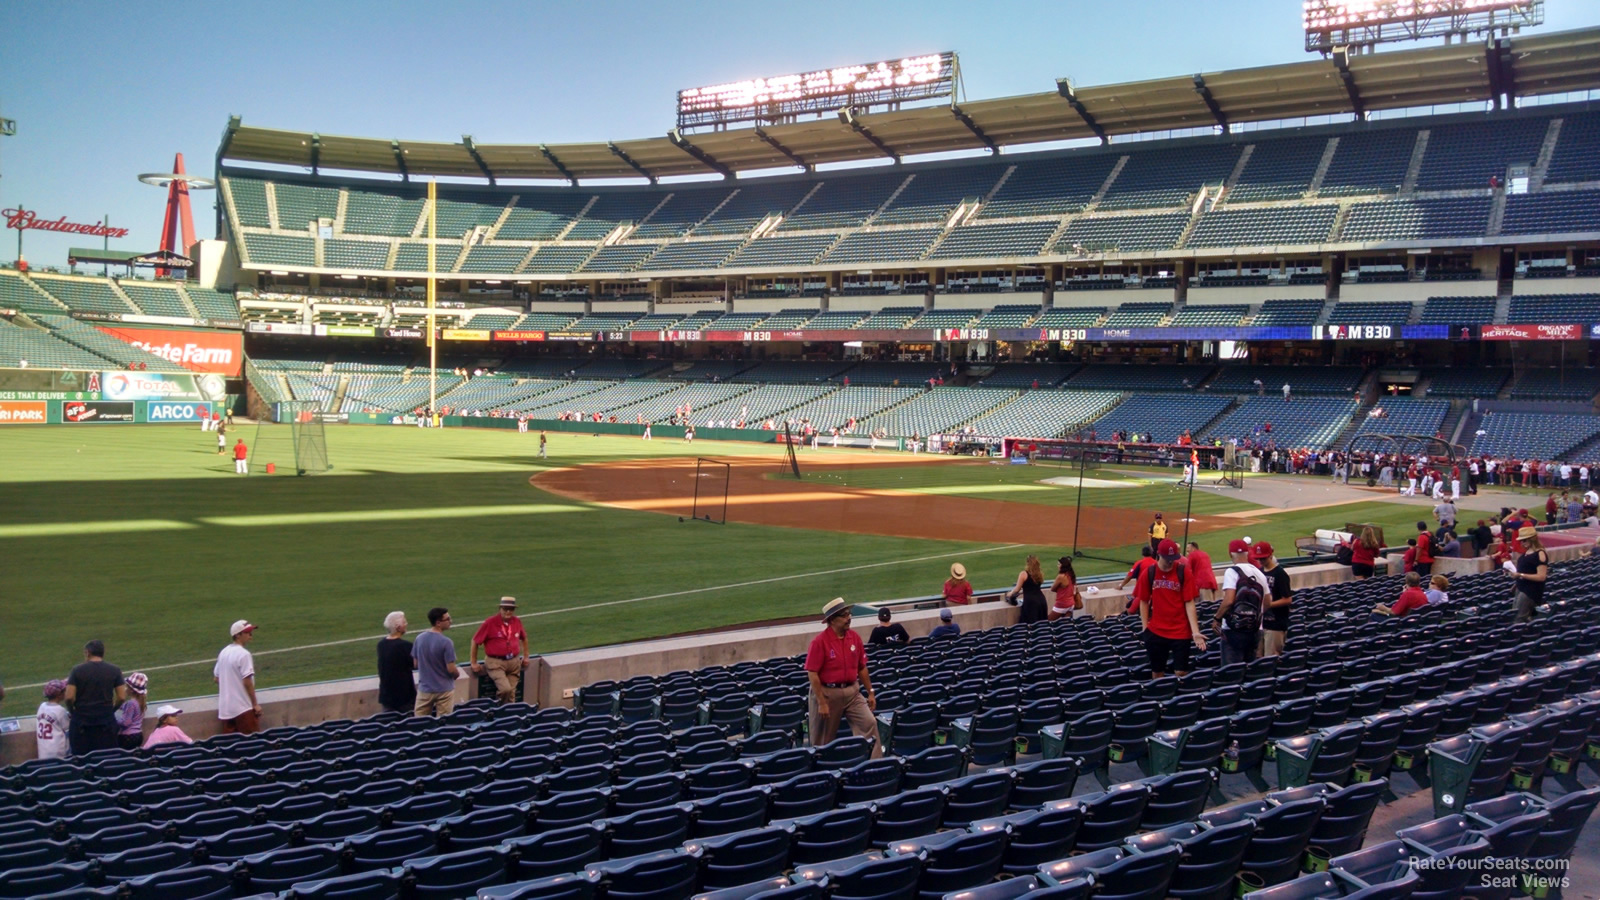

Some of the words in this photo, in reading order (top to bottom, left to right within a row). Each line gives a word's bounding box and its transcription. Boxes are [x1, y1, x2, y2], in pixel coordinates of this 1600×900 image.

[2, 208, 129, 237] Budweiser
[610, 332, 623, 340] 5:23
[687, 331, 700, 340] 830
[753, 332, 771, 341] 830
[970, 330, 989, 340] 830
[1062, 329, 1086, 340] 830
[1103, 329, 1130, 337] HOME
[1365, 325, 1391, 339] 830
[1482, 330, 1528, 338] HERITAGE
[17, 391, 36, 399] THAT
[13, 410, 43, 420] PARK
[152, 405, 194, 418] ARCO
[38, 722, 53, 739] 32
